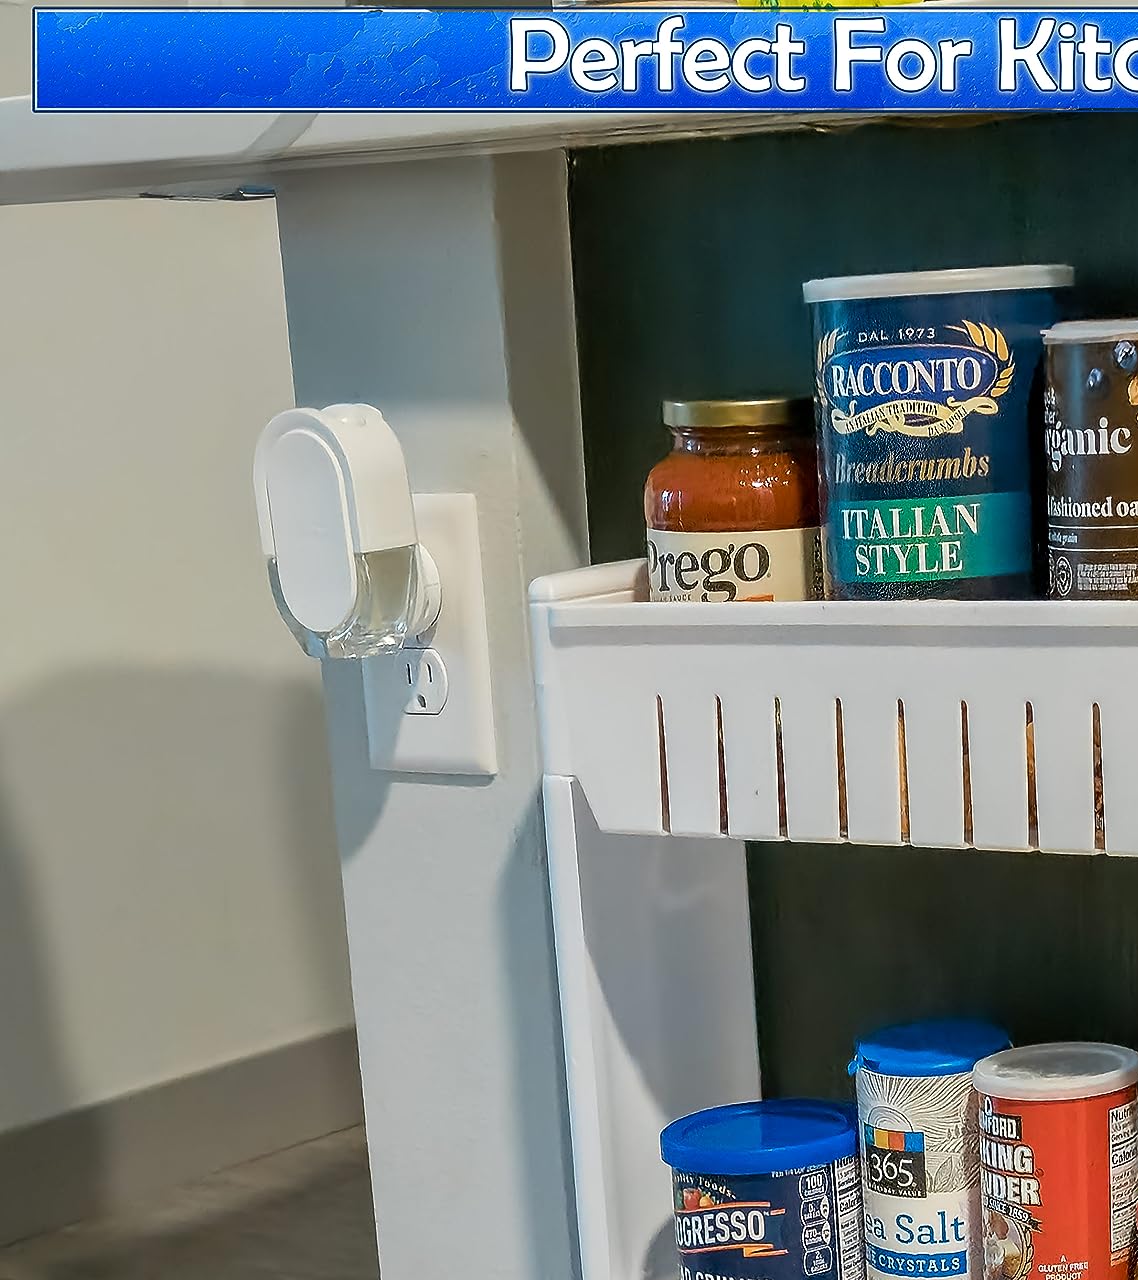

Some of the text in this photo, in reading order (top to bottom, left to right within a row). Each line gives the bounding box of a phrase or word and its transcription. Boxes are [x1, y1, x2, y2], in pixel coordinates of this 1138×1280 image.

[858, 328, 937, 343] DAL 1973
[832, 357, 982, 398] RACCONTO
[887, 401, 938, 416] TRADITION
[834, 447, 990, 485] Breadcrumbs
[841, 503, 981, 540] ITALIAN
[855, 541, 963, 576] STYLE
[870, 1153, 913, 1187] 365
[806, 1174, 823, 1190] 100
[1008, 1205, 1028, 1222] 1859
[895, 1210, 966, 1244] Salt
[878, 1254, 960, 1272] CRYSTALS
[1038, 1261, 1089, 1272] GLUTEN FREE
[1060, 1255, 1067, 1263] A
